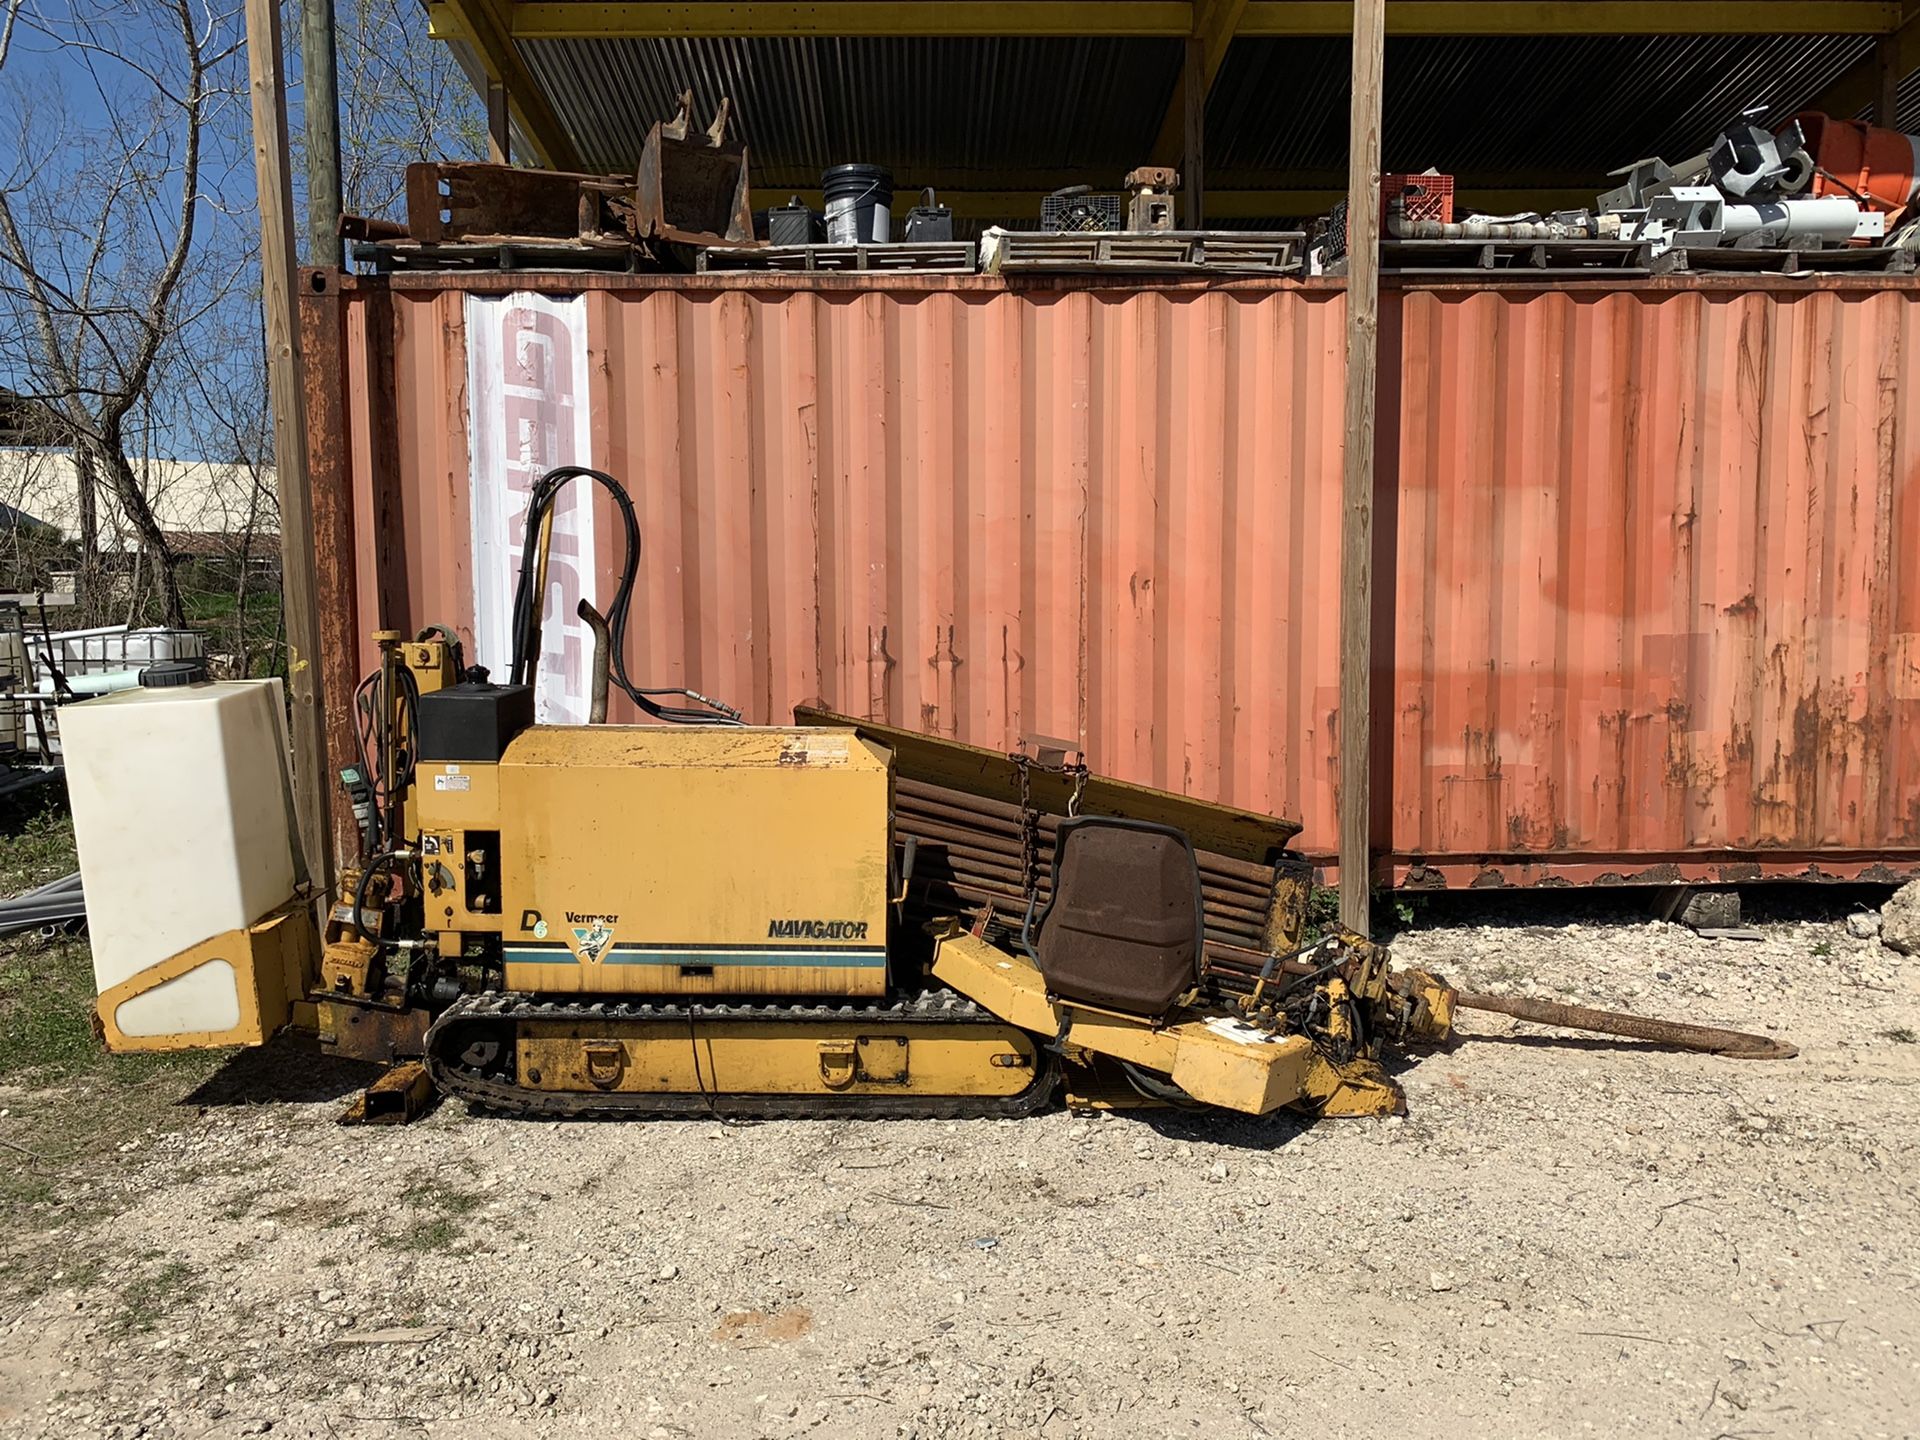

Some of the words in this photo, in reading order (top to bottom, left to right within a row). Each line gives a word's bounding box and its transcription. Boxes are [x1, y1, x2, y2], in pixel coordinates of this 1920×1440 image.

[503, 307, 582, 724] GENST
[565, 911, 619, 923] Vermeer
[768, 919, 868, 940] NAVIGATOR
